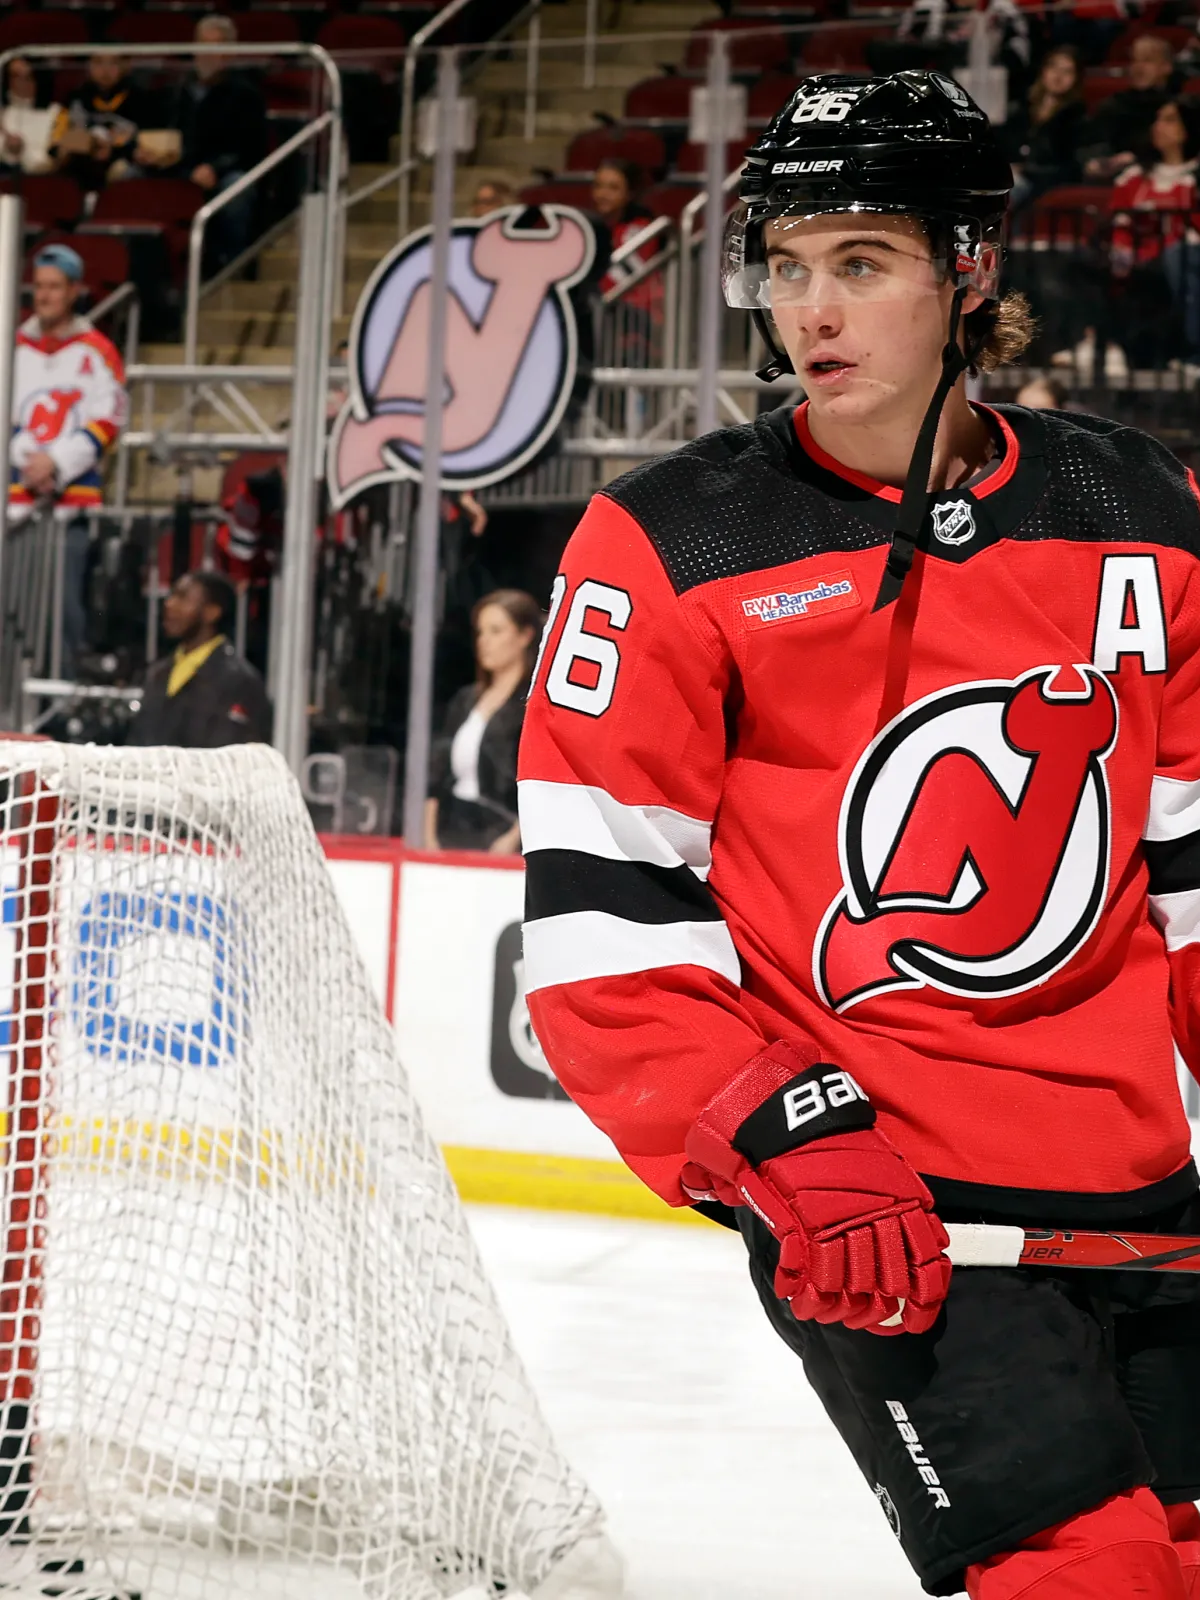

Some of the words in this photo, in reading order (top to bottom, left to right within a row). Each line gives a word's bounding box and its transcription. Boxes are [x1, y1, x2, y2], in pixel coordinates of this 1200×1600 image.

[791, 93, 858, 123] 86
[771, 160, 844, 174] BAUER
[743, 580, 852, 615] RWJBarnabas
[762, 602, 807, 620] HEALTH
[1090, 553, 1168, 674] A
[885, 1400, 951, 1509] BAUER
